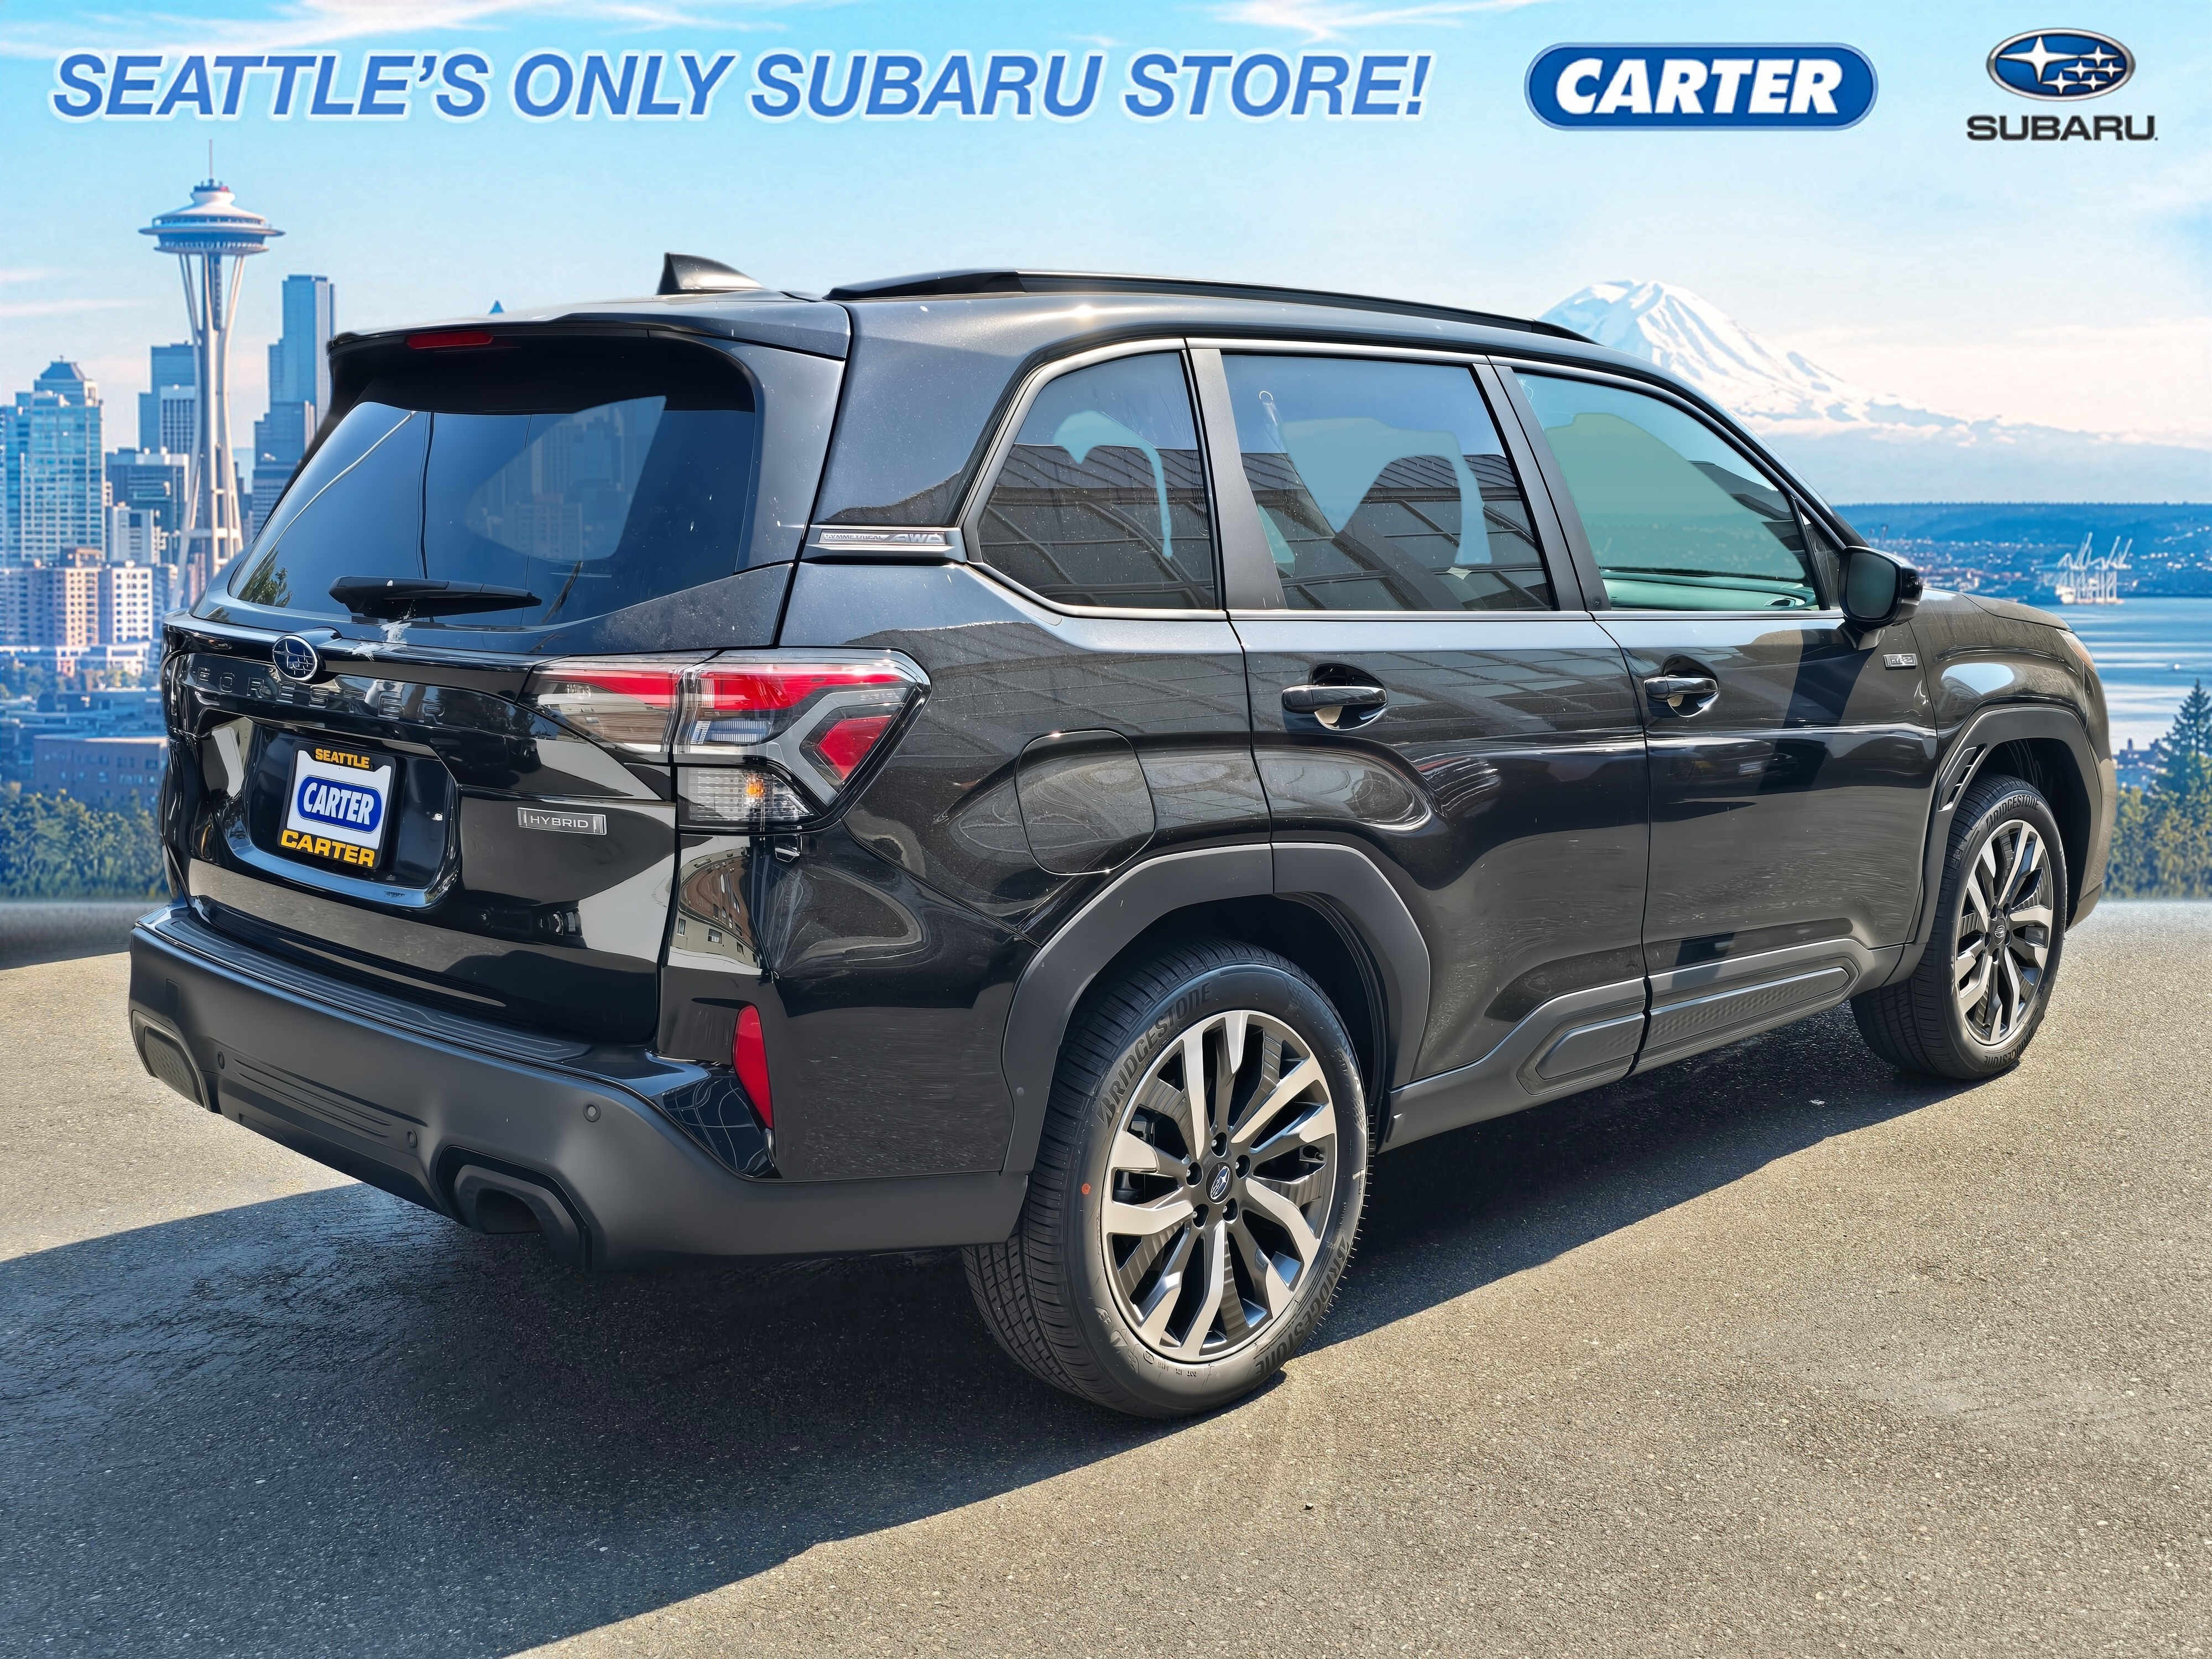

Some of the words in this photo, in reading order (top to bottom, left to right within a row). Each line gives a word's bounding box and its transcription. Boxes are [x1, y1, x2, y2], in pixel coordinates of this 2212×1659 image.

[889, 533, 942, 542] AWD
[315, 748, 370, 769] SEATTLE
[303, 782, 374, 825] CARTER
[530, 815, 588, 828] HYBRID
[280, 830, 375, 867] CARTER
[1097, 982, 1211, 1129] BRIDGESTONE
[1254, 1234, 1349, 1377] BRIDGESTONE
